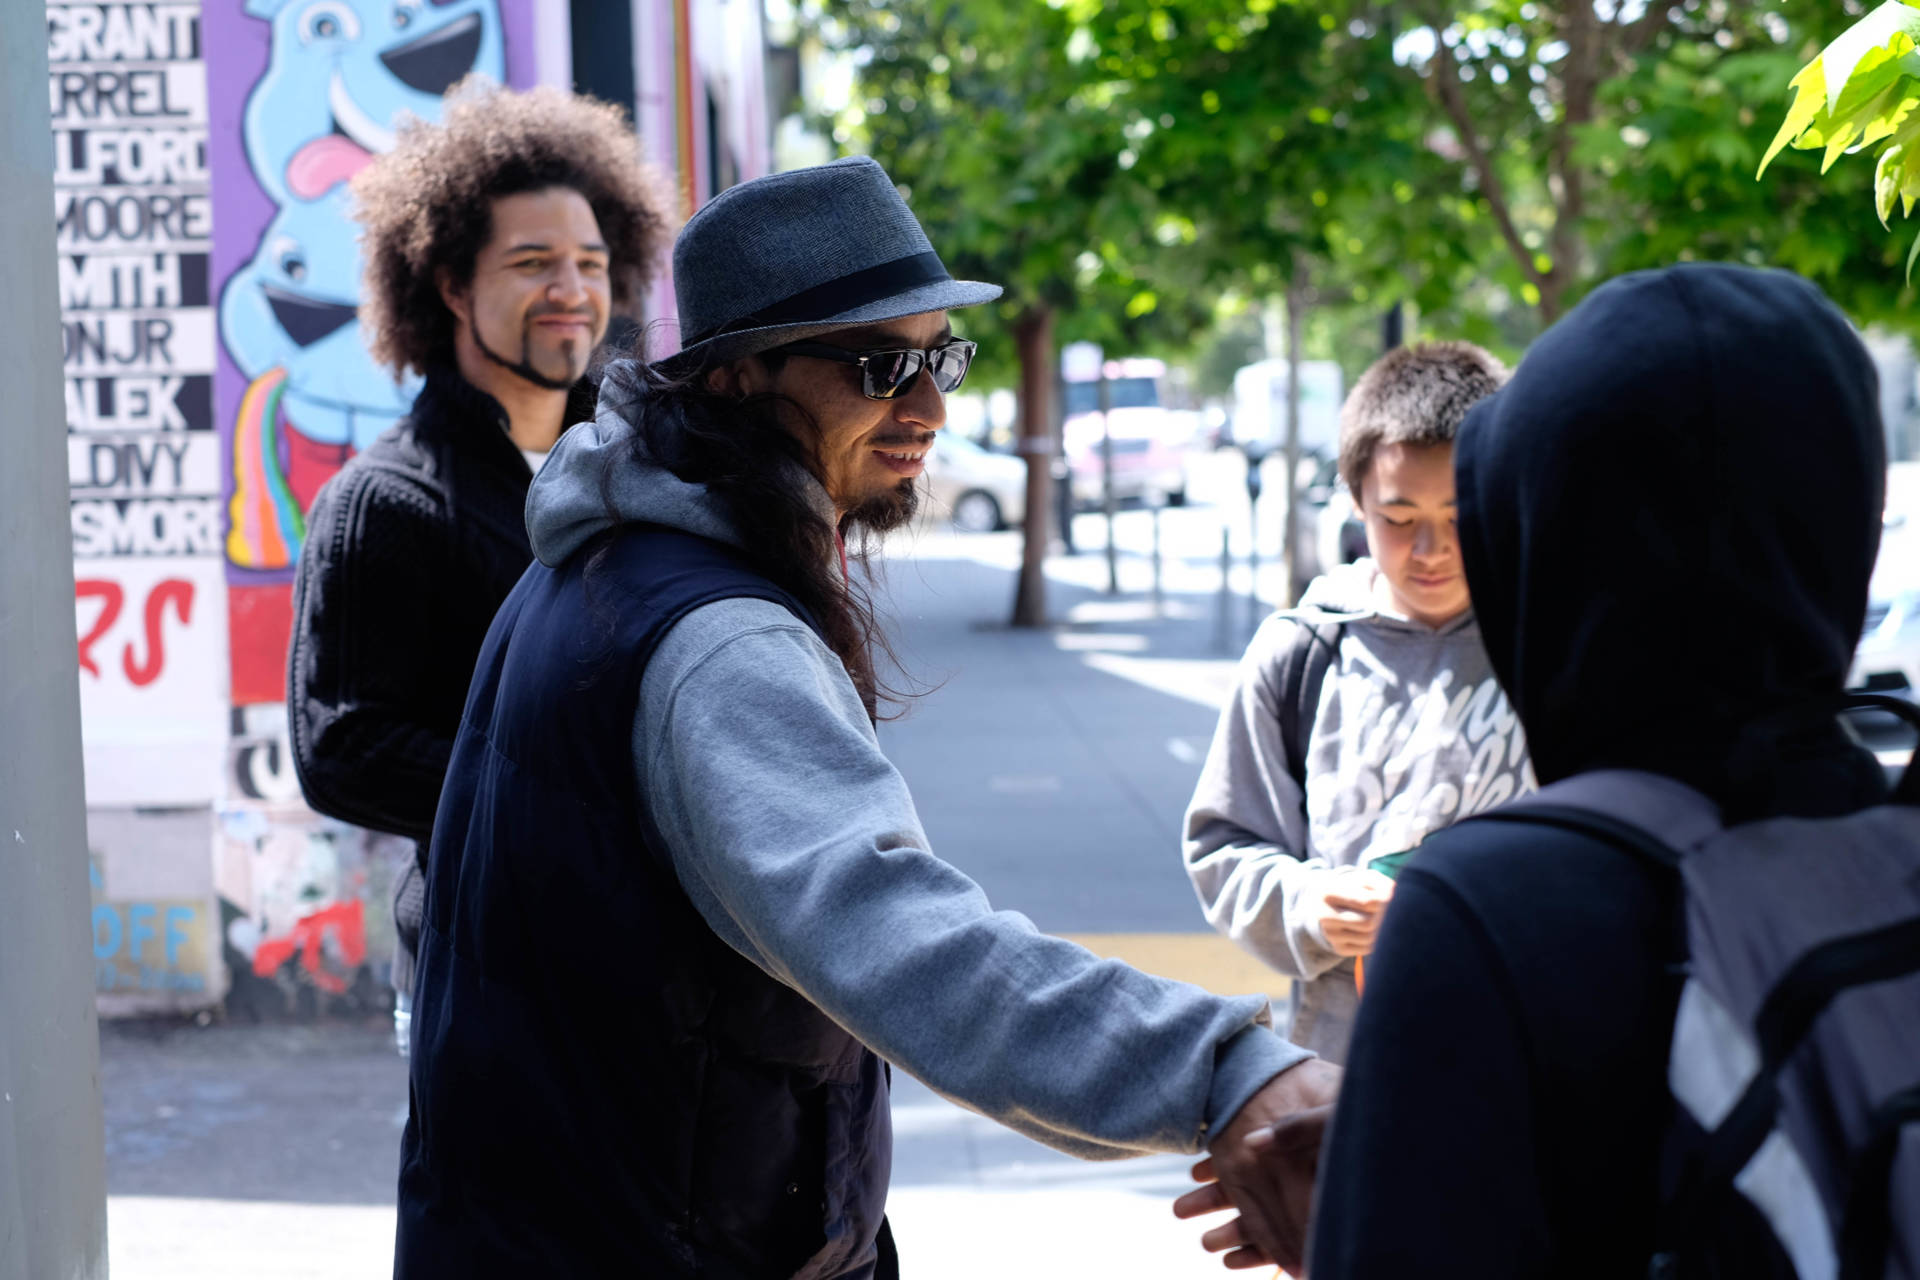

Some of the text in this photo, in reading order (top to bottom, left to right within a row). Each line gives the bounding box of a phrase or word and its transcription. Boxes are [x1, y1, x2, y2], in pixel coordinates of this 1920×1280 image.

[47, 5, 201, 60] GRANT
[59, 254, 182, 308] MITH
[92, 903, 196, 964] OFF
